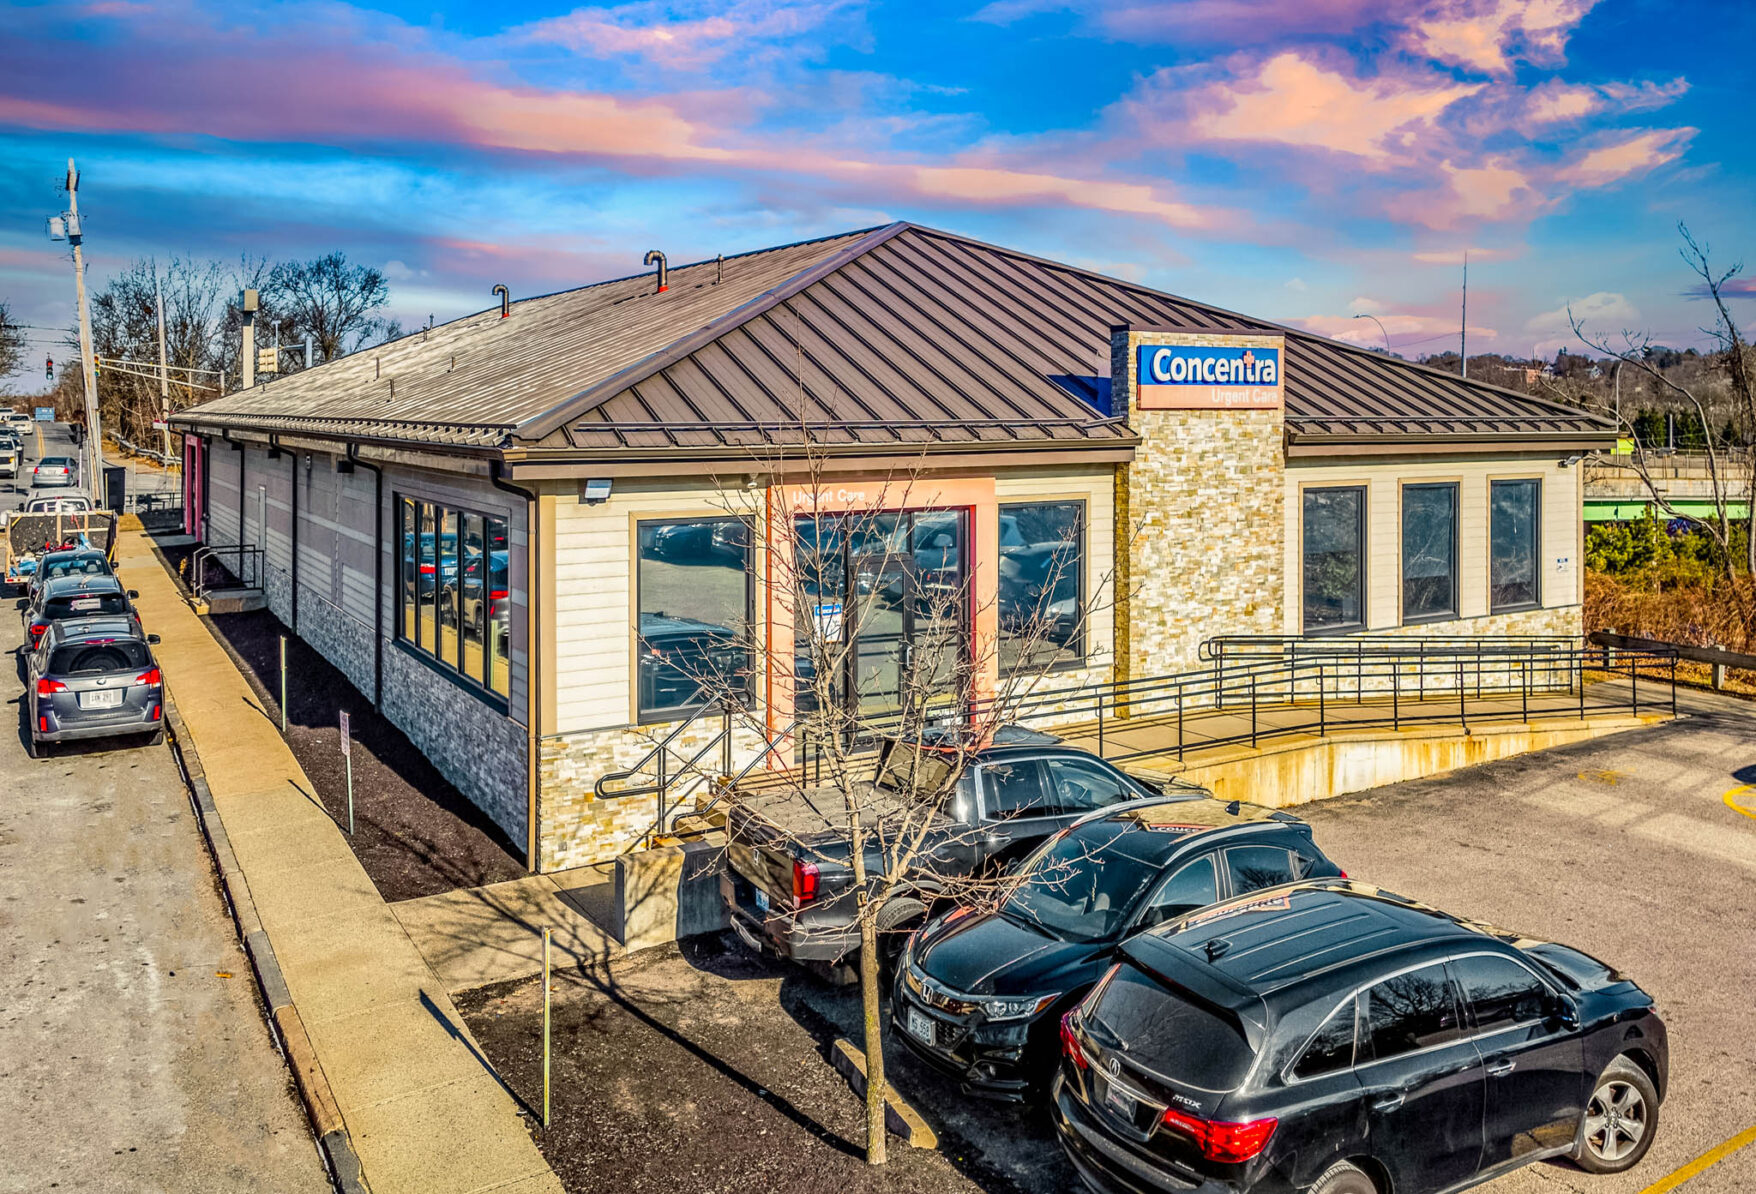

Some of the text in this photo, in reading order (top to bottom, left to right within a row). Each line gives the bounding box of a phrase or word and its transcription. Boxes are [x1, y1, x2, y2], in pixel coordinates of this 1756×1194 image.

[1153, 347, 1276, 383] Concentra
[1211, 388, 1279, 406] Urgent Care
[837, 489, 865, 503] Care
